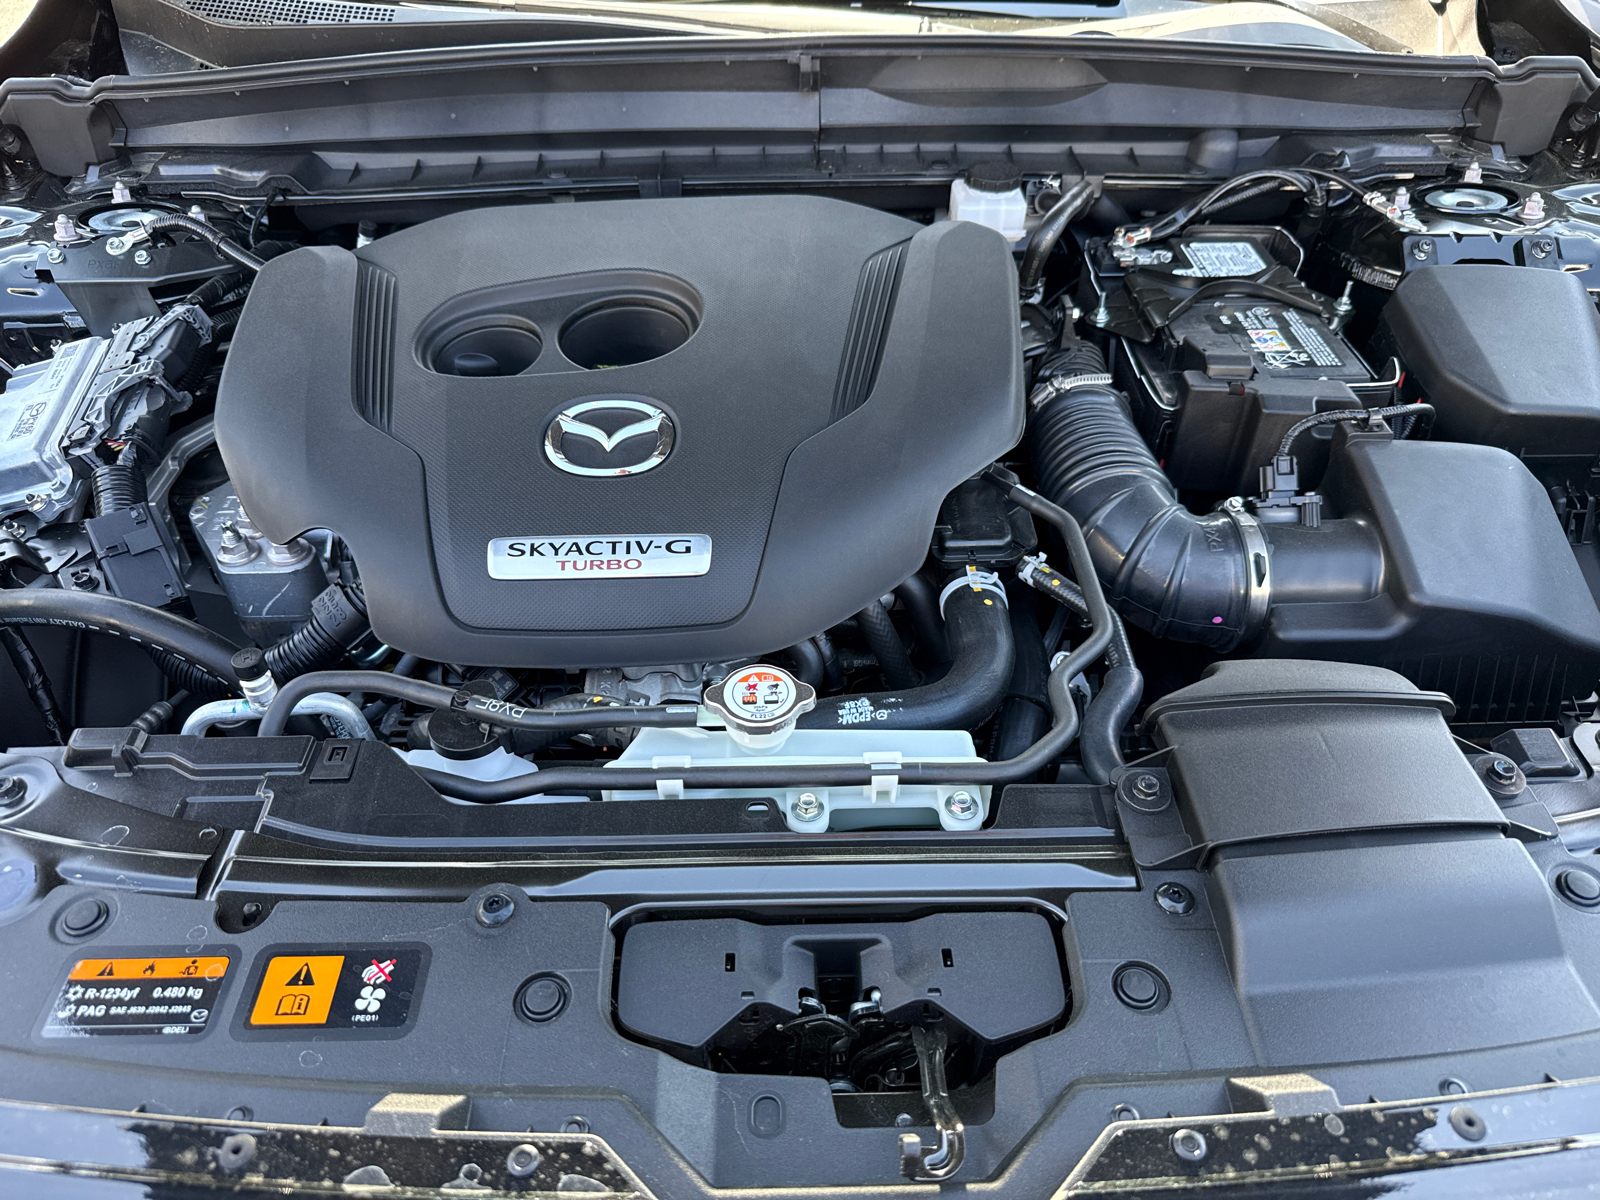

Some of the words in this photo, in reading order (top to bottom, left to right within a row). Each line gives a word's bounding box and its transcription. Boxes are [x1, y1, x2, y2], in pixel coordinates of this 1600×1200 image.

[507, 539, 692, 557] SKYACTIV-G
[556, 558, 642, 571] TURBO
[48, 618, 86, 629] GALAXY
[475, 698, 528, 719] PX8F
[84, 987, 140, 1001] R-1234yf
[152, 986, 186, 998] 0.480
[187, 987, 203, 1000] kg
[77, 1005, 106, 1016] PAG
[109, 1006, 126, 1015] SAE
[127, 1006, 145, 1014] J639
